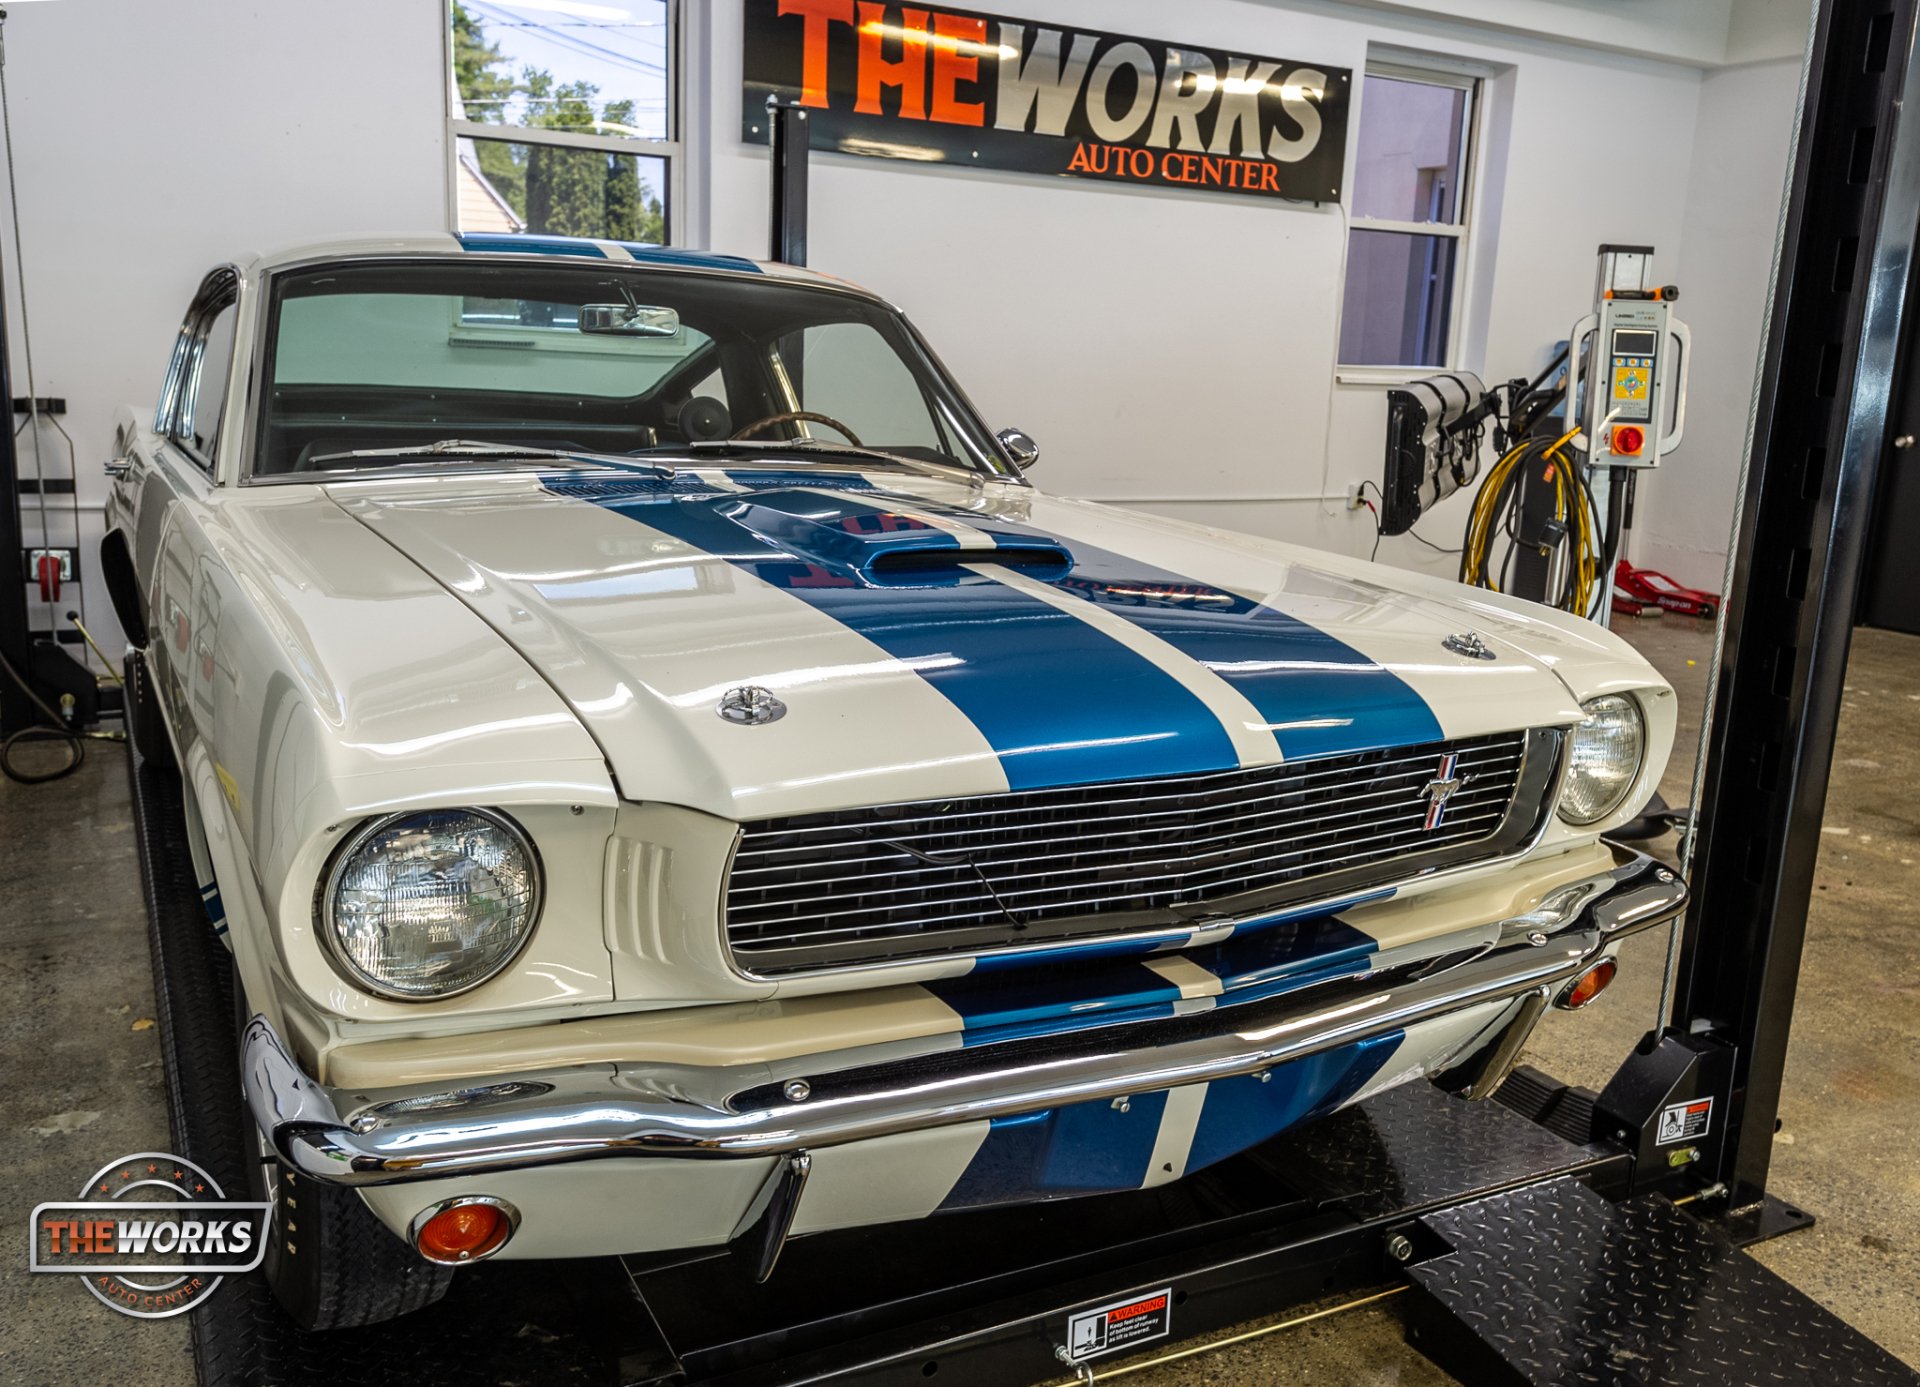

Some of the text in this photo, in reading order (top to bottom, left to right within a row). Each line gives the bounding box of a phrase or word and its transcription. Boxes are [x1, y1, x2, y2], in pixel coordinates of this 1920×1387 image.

[1067, 142, 1281, 192] AUTO CENTER
[1119, 1298, 1163, 1318] WARNING
[1116, 1326, 1133, 1334] bottom
[1140, 1318, 1159, 1327] runway
